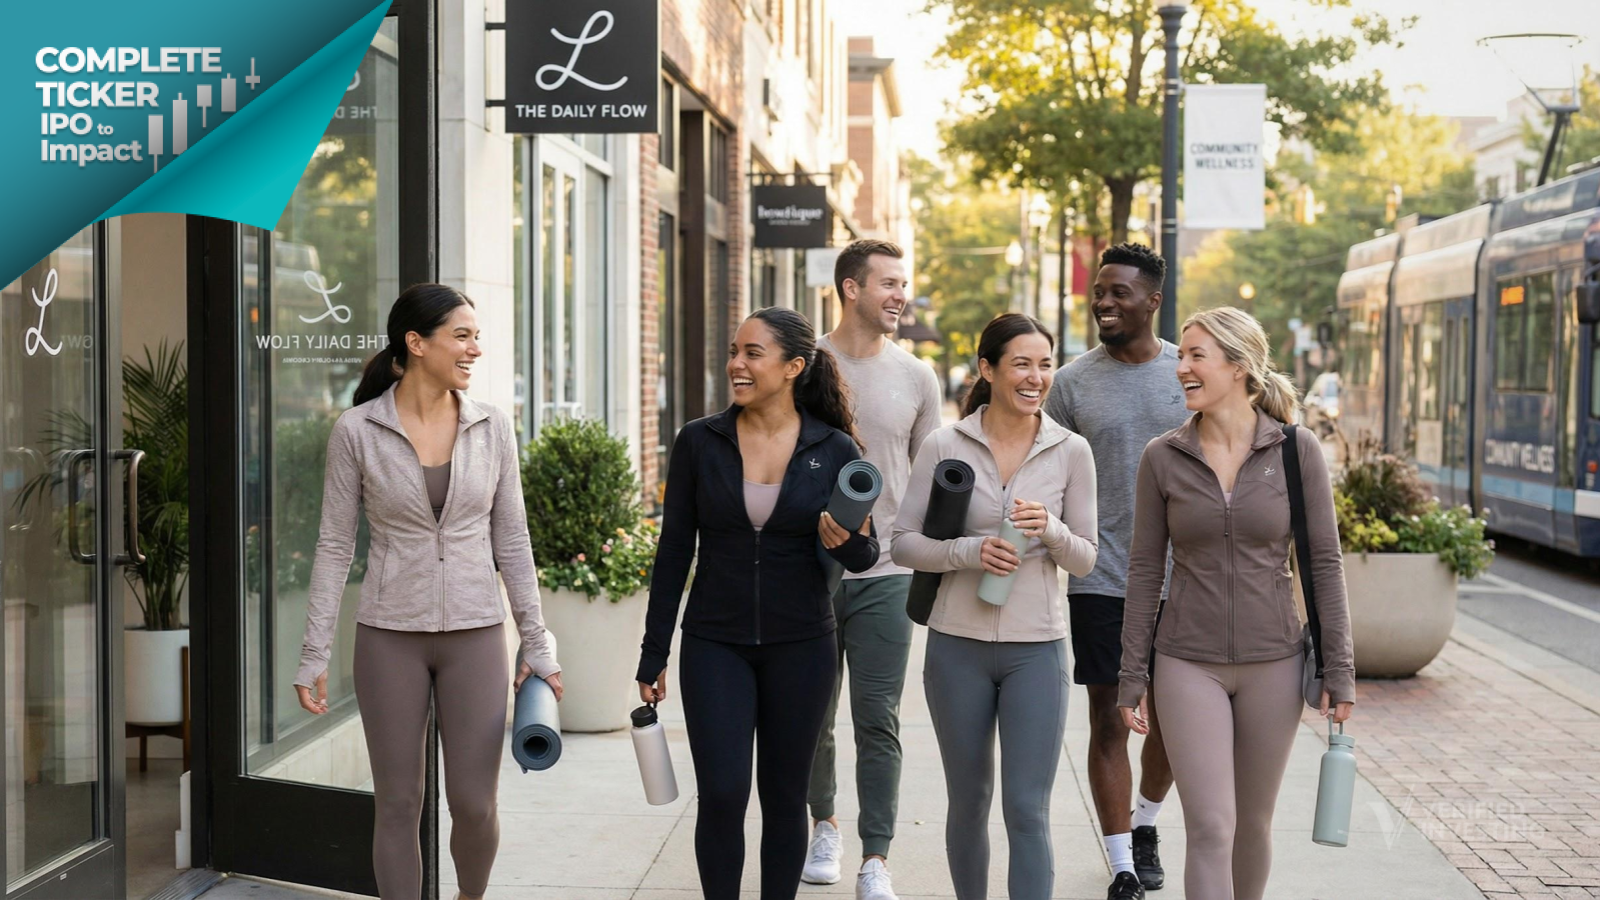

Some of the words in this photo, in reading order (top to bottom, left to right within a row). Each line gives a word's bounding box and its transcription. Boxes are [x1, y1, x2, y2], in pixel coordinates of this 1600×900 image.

[515, 104, 546, 118] THE
[552, 104, 597, 118] DAILY
[601, 104, 648, 118] FLOW
[1190, 143, 1258, 155] COMMUNITY
[1195, 158, 1255, 169] WELLNESS
